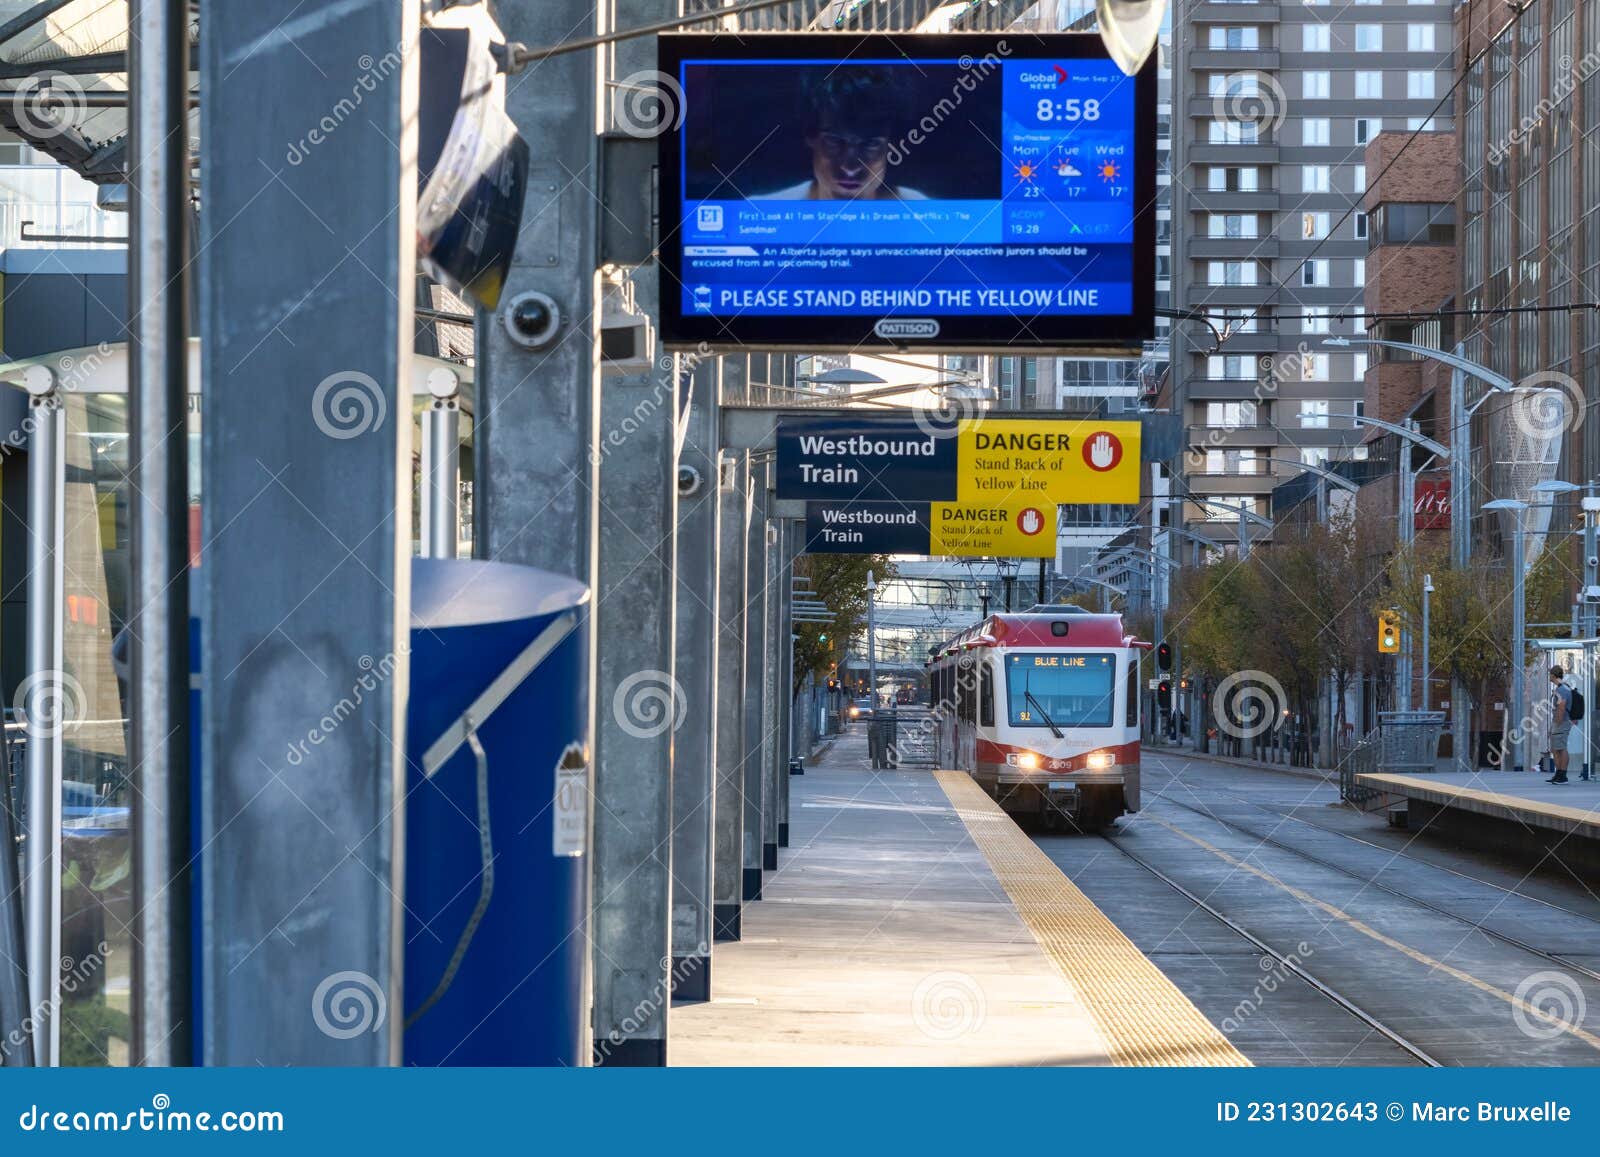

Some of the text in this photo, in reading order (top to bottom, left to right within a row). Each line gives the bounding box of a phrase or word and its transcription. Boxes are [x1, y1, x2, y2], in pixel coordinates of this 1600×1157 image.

[1020, 72, 1057, 83] Global
[1036, 98, 1100, 121] 8:58
[1013, 145, 1040, 156] Mon
[1057, 145, 1080, 155] Tue
[1095, 145, 1124, 155] Wed
[739, 211, 759, 221] First
[761, 211, 781, 221] Look
[739, 225, 777, 235] Sandman
[1010, 224, 1040, 234] 19.28
[763, 245, 1088, 258] An Alberta judge says unvaccinated prospective jurors should be
[692, 258, 852, 269] excused from an upcoming trial.
[720, 290, 1099, 307] PLEASE STAND BEHIND THE YELLOW LINE
[881, 323, 934, 334] PATTISON
[799, 436, 936, 457] Westbound
[975, 433, 1071, 451] DANGER
[974, 457, 1064, 472] Stand Back of
[799, 463, 859, 484] Train
[974, 476, 1048, 491] Yellow Line
[821, 509, 917, 525] Westbound
[942, 508, 1009, 523] DANGER
[821, 529, 863, 543] Train
[942, 525, 1003, 536] Stand Back of
[942, 538, 993, 549] Yellow Line
[1034, 656, 1086, 667] BLUE LINE
